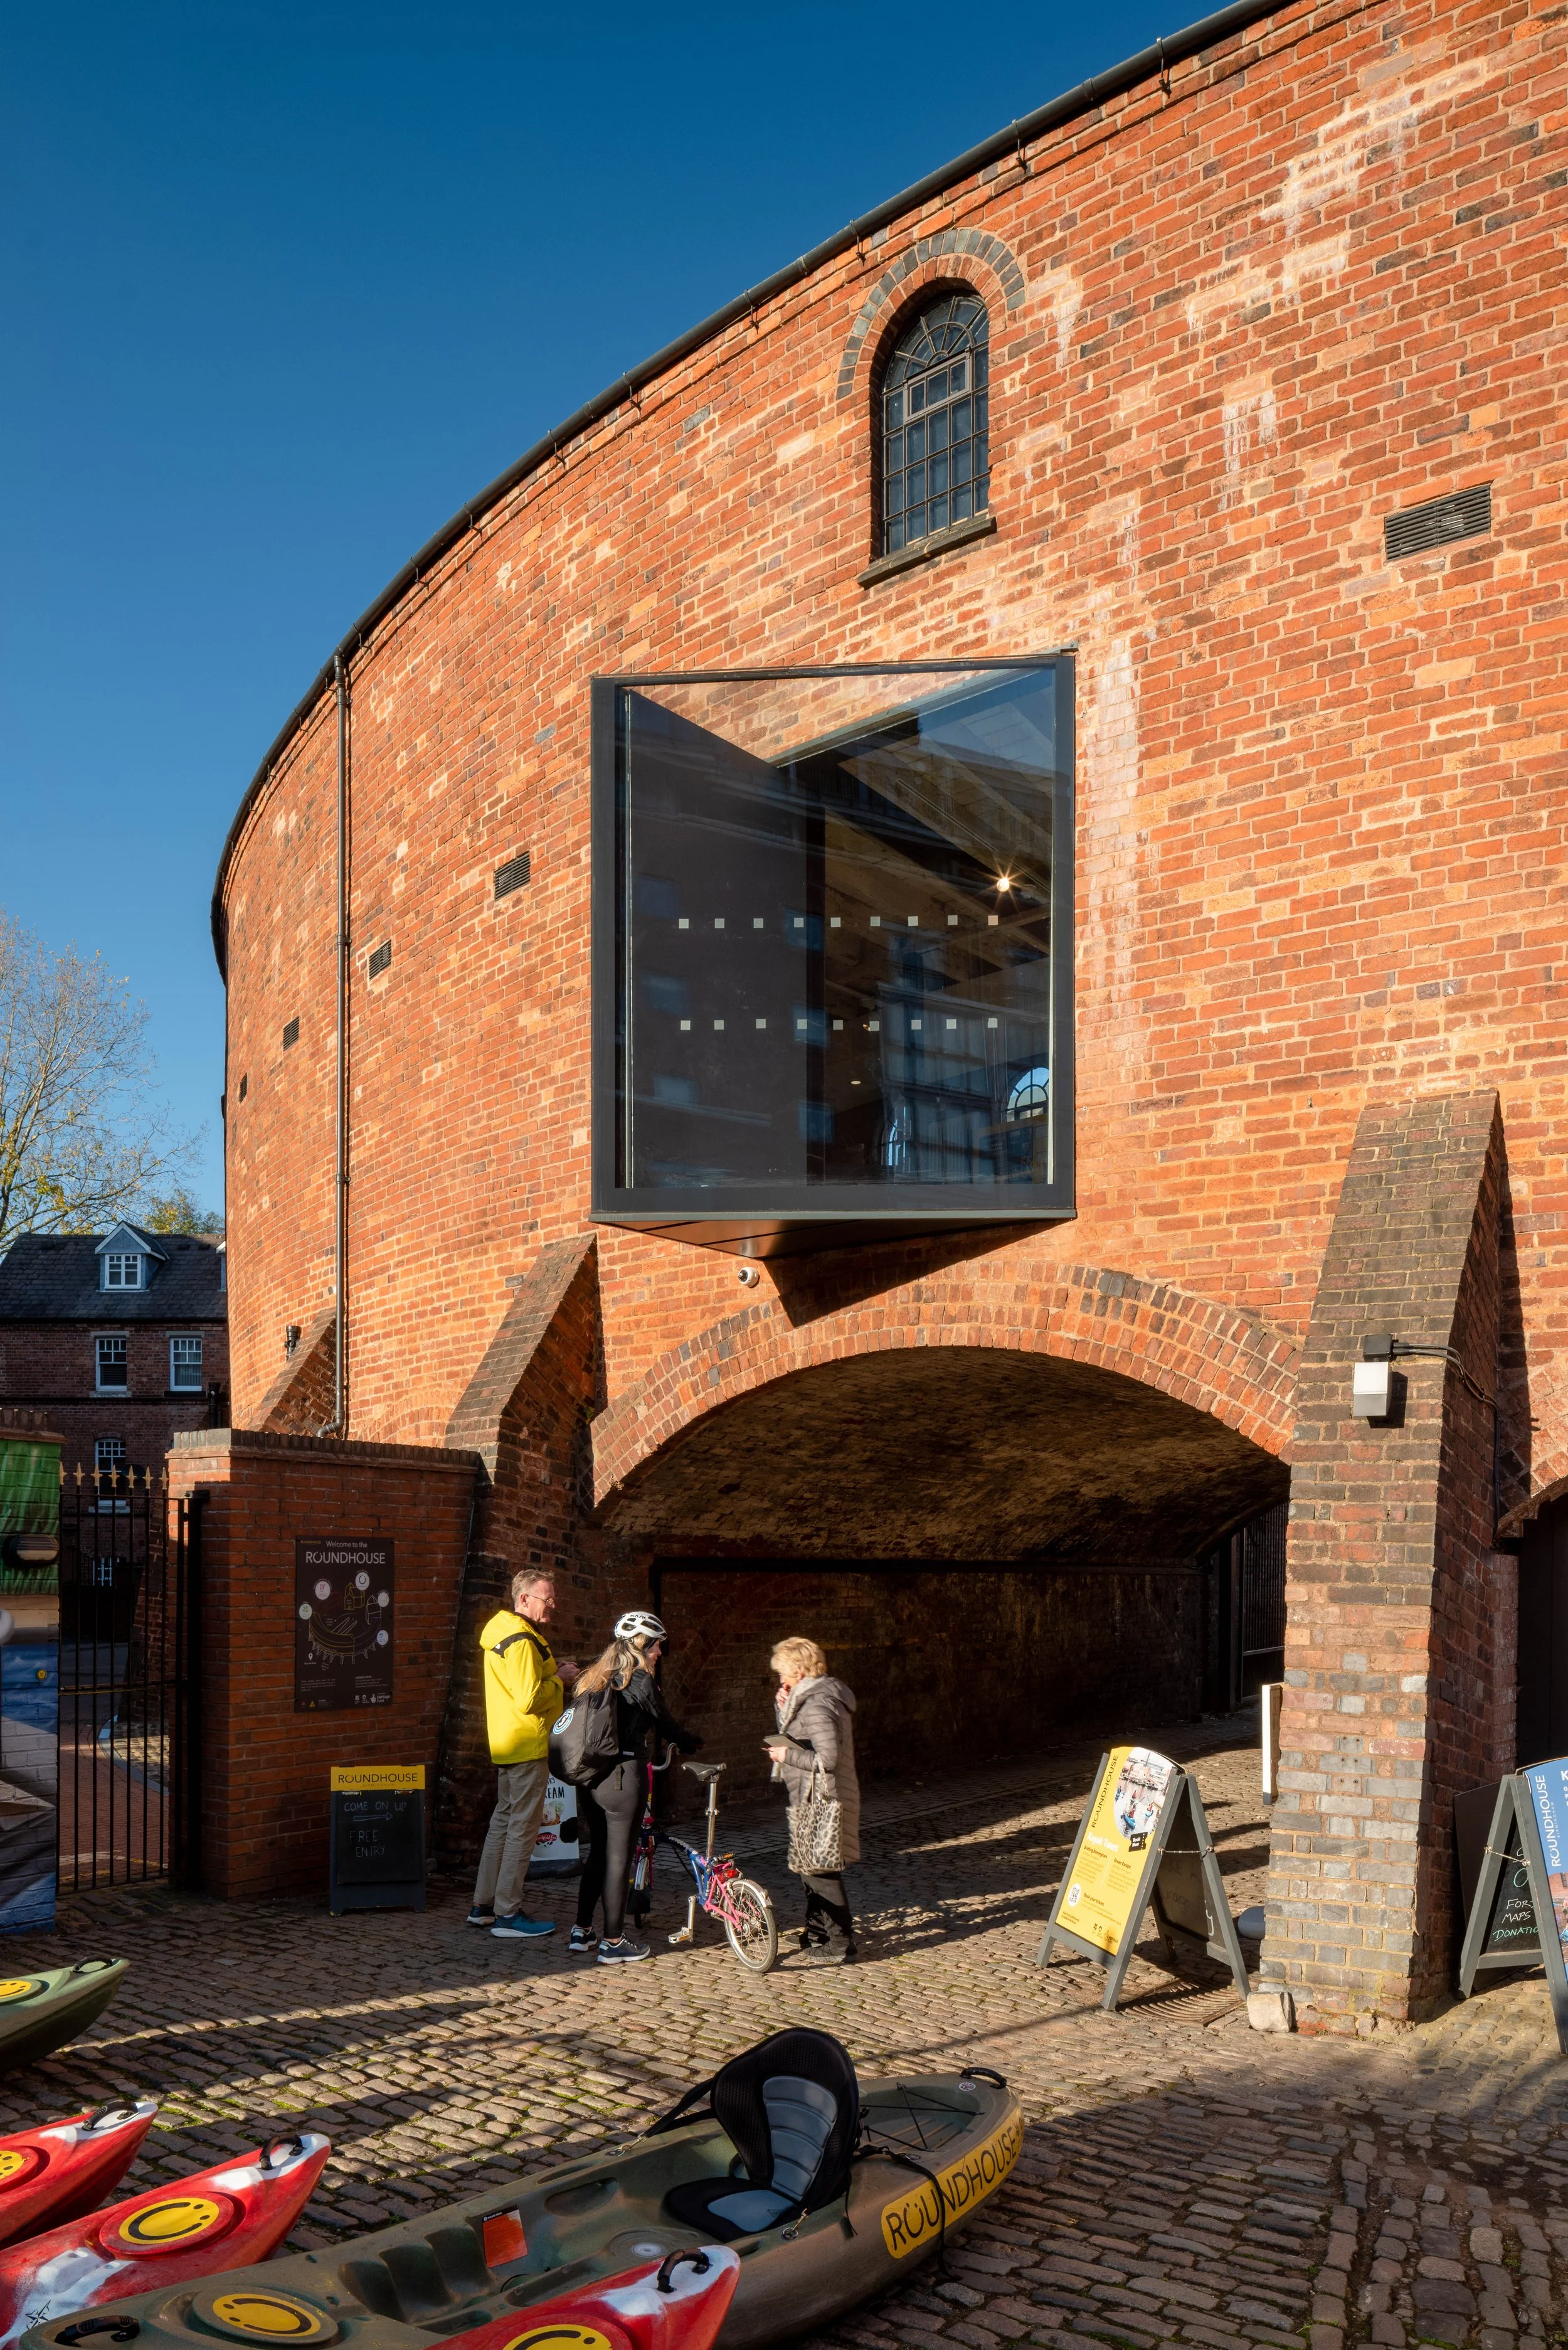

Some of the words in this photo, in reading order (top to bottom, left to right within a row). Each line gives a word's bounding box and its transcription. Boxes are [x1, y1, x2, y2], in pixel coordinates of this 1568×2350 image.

[545, 1786, 565, 1799] EAM
[344, 1802, 369, 1812] COME
[375, 1801, 388, 1810] ON
[395, 1802, 407, 1812] UP
[1550, 1802, 1560, 1838] BIRMINGHAM
[349, 1829, 379, 1843] FREE
[1087, 1832, 1104, 1846] Kayak
[1103, 1837, 1120, 1853] Tours
[356, 1844, 386, 1858] ENTRY
[1093, 1849, 1108, 1858] Birmingham
[1113, 1858, 1122, 1866] Green
[1502, 1911, 1531, 1923] MAPS
